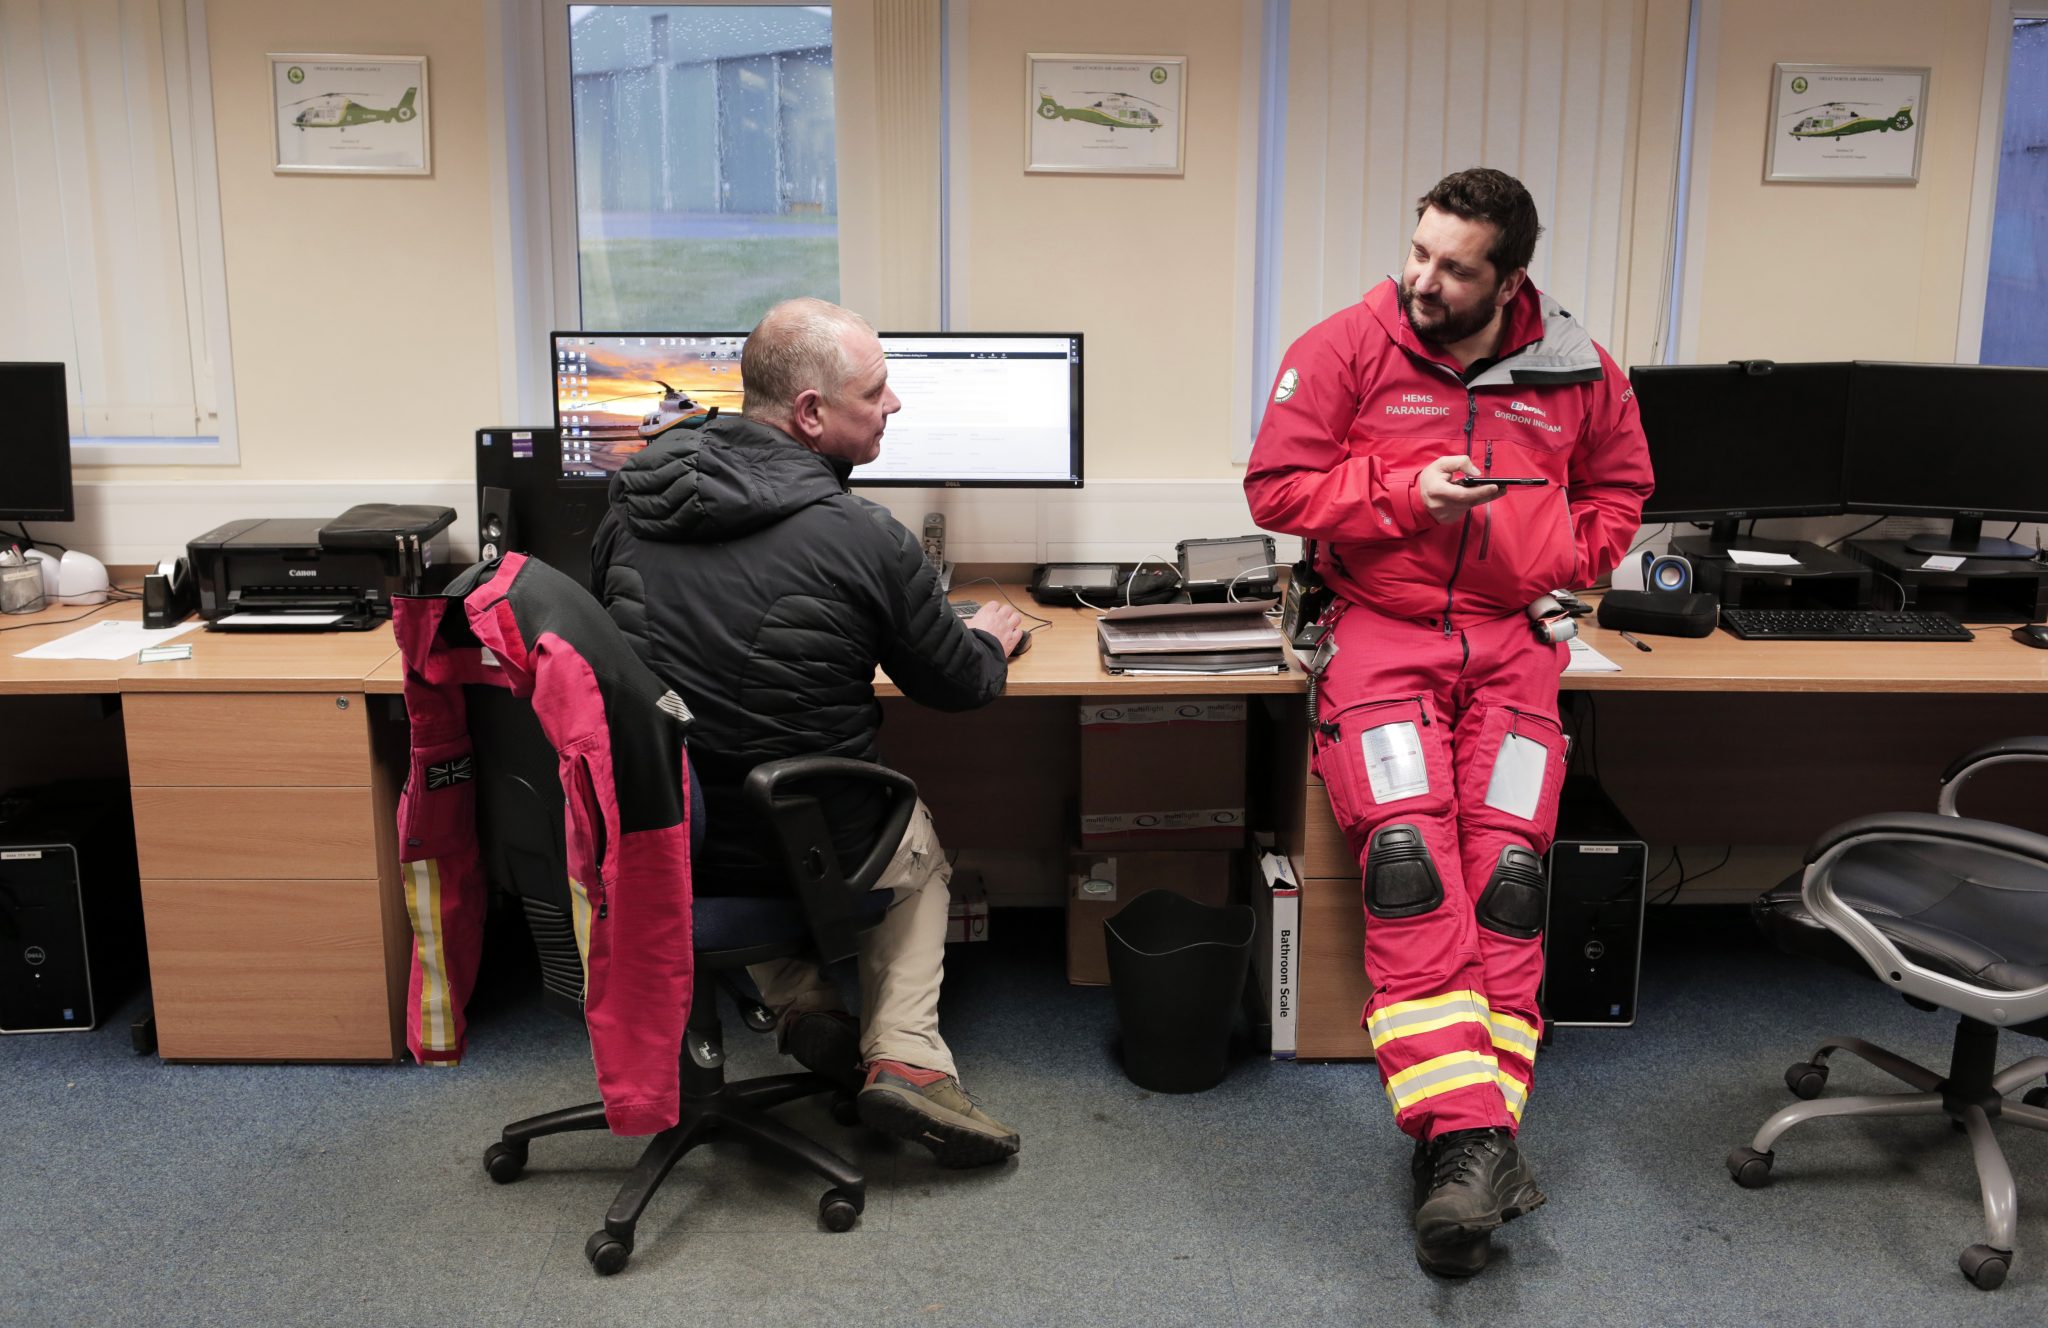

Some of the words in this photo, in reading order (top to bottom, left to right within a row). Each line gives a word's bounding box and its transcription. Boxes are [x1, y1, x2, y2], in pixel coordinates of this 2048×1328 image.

[1402, 393, 1433, 403] HEMS
[1385, 405, 1450, 416] PARAMEDIC
[1494, 410, 1531, 425] GORDON
[1532, 418, 1562, 432] INGRAM
[288, 569, 317, 577] Canon
[1127, 705, 1164, 714] multiflight
[1207, 703, 1244, 712] multiflight
[1086, 815, 1122, 825] multiflight
[1280, 929, 1291, 985] Bathroom
[1279, 987, 1290, 1018] Scale
